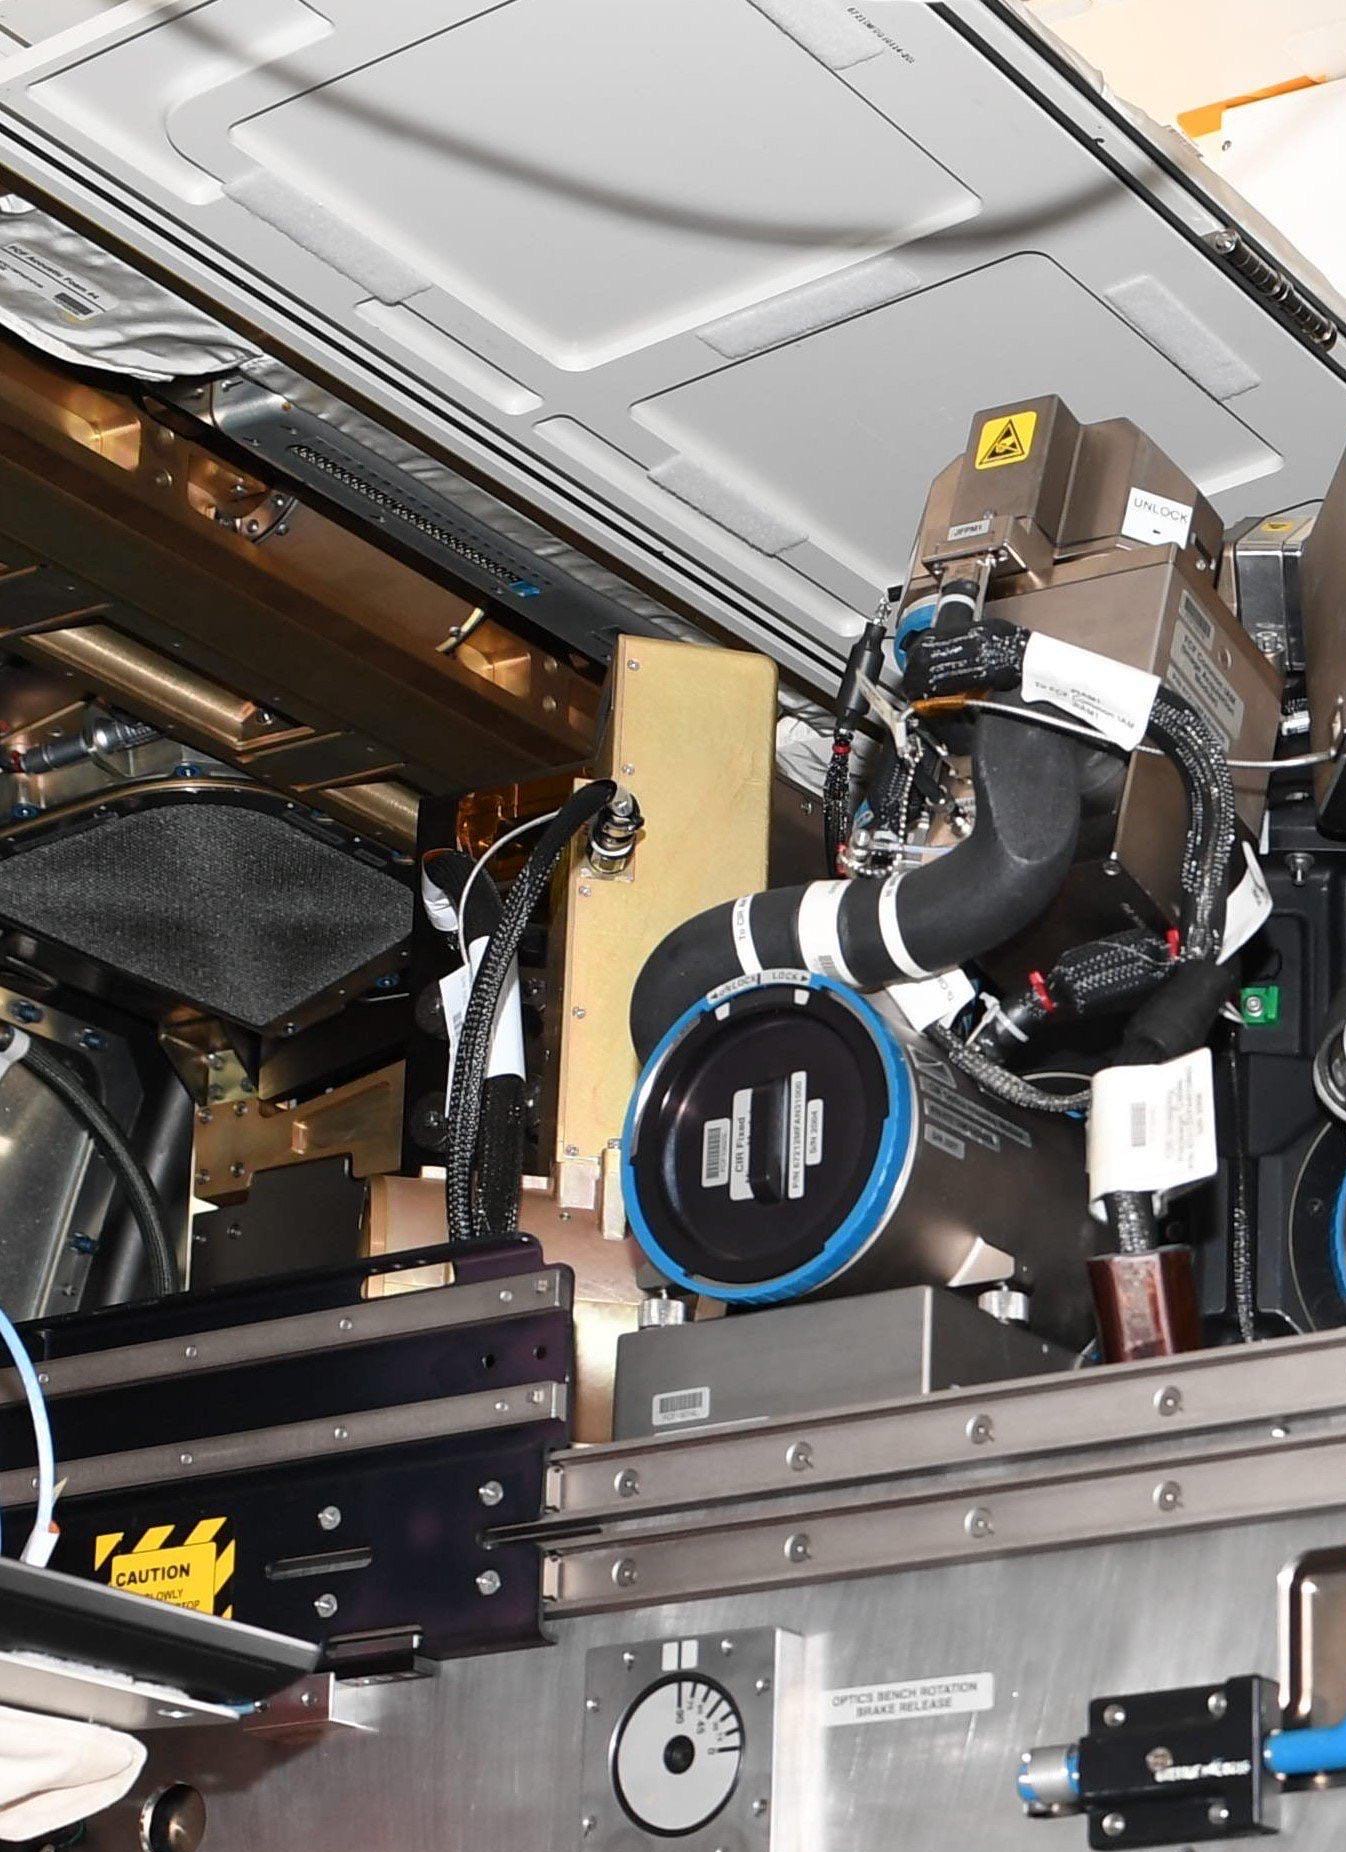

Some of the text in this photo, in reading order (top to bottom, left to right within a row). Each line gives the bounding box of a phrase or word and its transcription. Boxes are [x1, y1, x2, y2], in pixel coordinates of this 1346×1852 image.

[1133, 498, 1188, 523] UNLOCK
[738, 907, 746, 928] CIR
[772, 971, 799, 982] LOCK
[736, 1116, 745, 1147] Fixed
[809, 1136, 817, 1153] S/N
[116, 1563, 190, 1587] CAUTION
[832, 1681, 977, 1707] OPTICS BENCH ROTATION
[856, 1698, 951, 1718] BRAKE RELEASE
